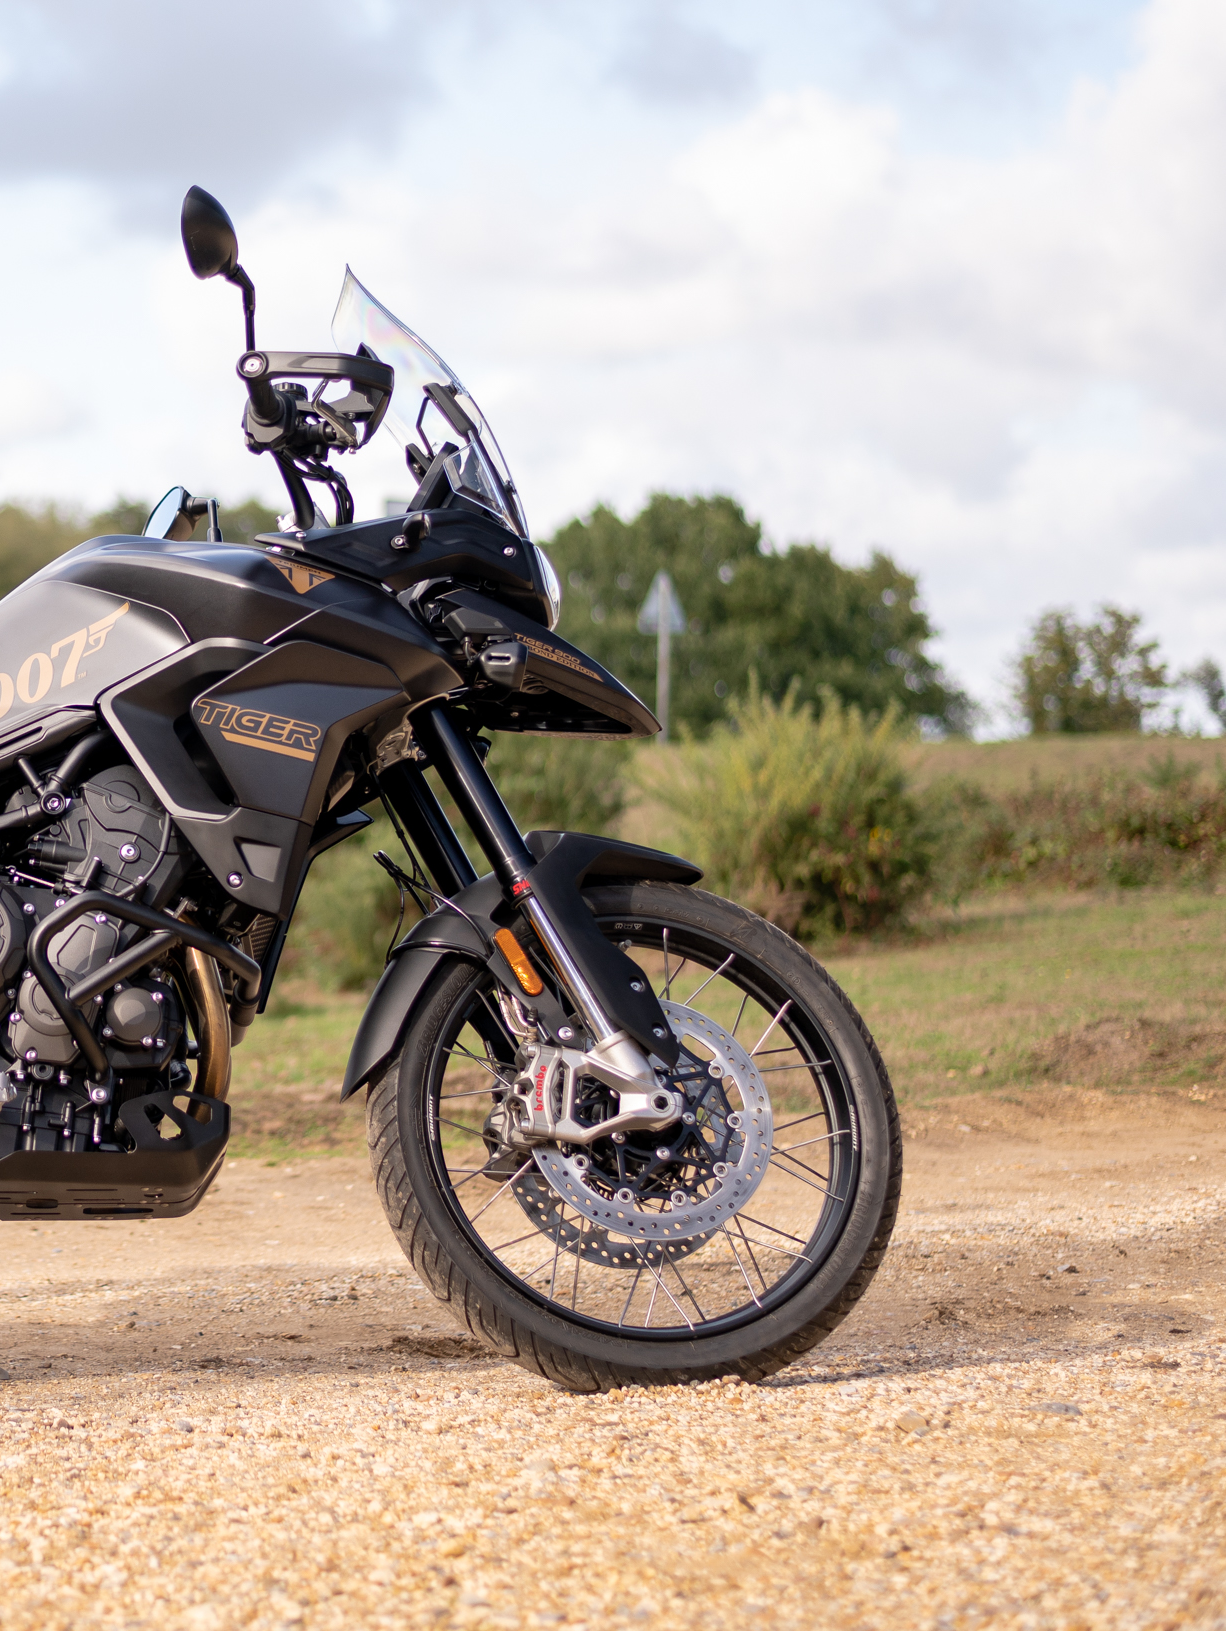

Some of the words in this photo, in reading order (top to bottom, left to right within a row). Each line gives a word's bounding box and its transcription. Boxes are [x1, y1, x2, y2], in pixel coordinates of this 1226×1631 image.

[514, 632, 553, 653] TIGER
[554, 649, 581, 665] 900
[556, 655, 596, 677] EDITION
[197, 698, 321, 750] TIGER
[534, 1065, 548, 1112] brembo
